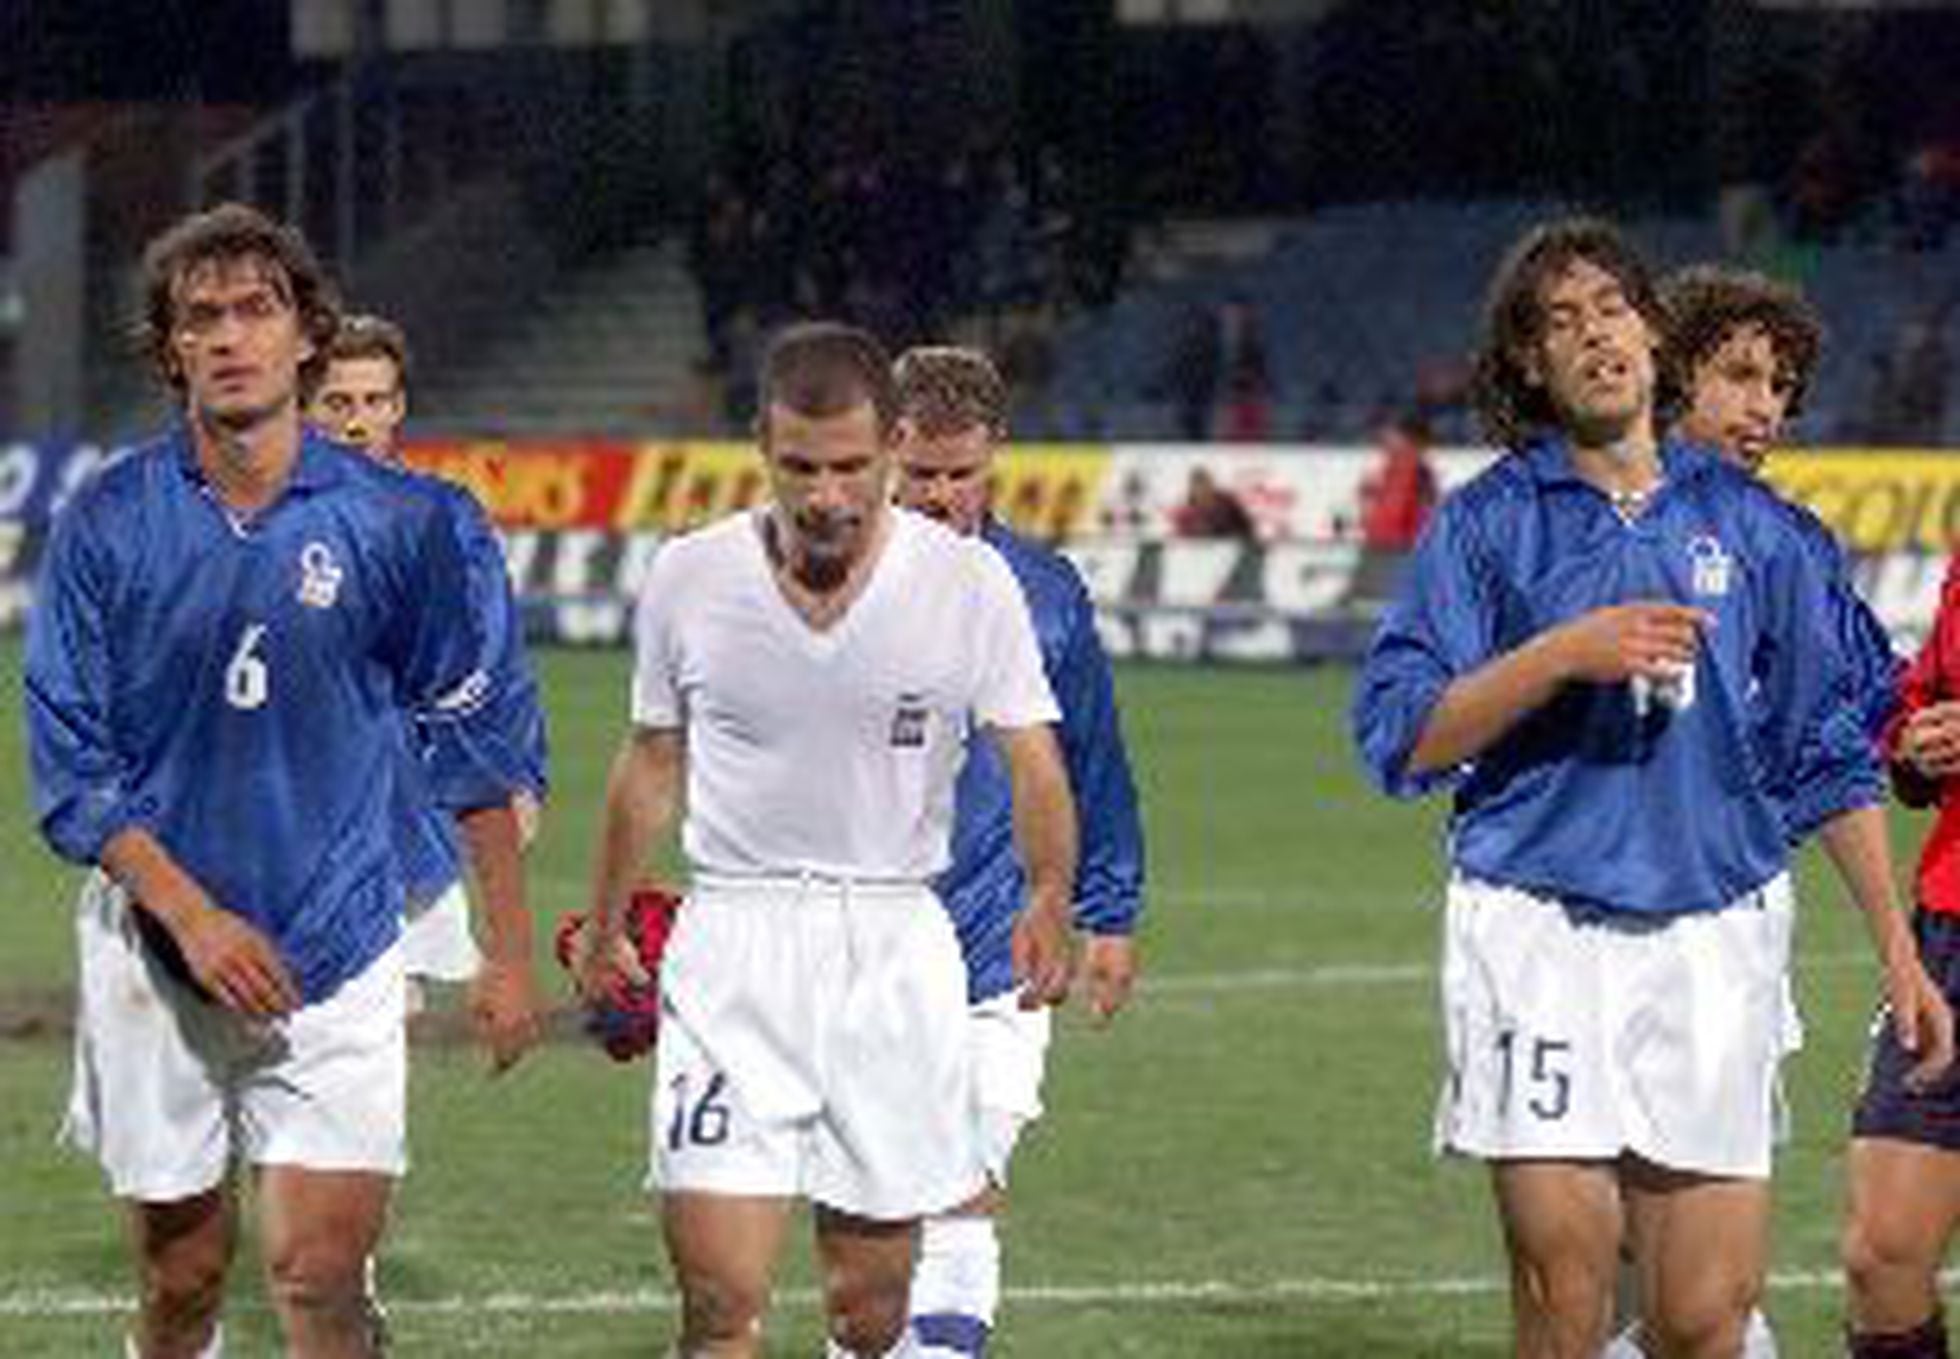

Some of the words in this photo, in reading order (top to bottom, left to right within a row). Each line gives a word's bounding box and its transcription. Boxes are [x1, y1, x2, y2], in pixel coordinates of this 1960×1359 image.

[226, 623, 267, 710] 6
[668, 1072, 729, 1151] 16
[1495, 1030, 1569, 1121] 15
